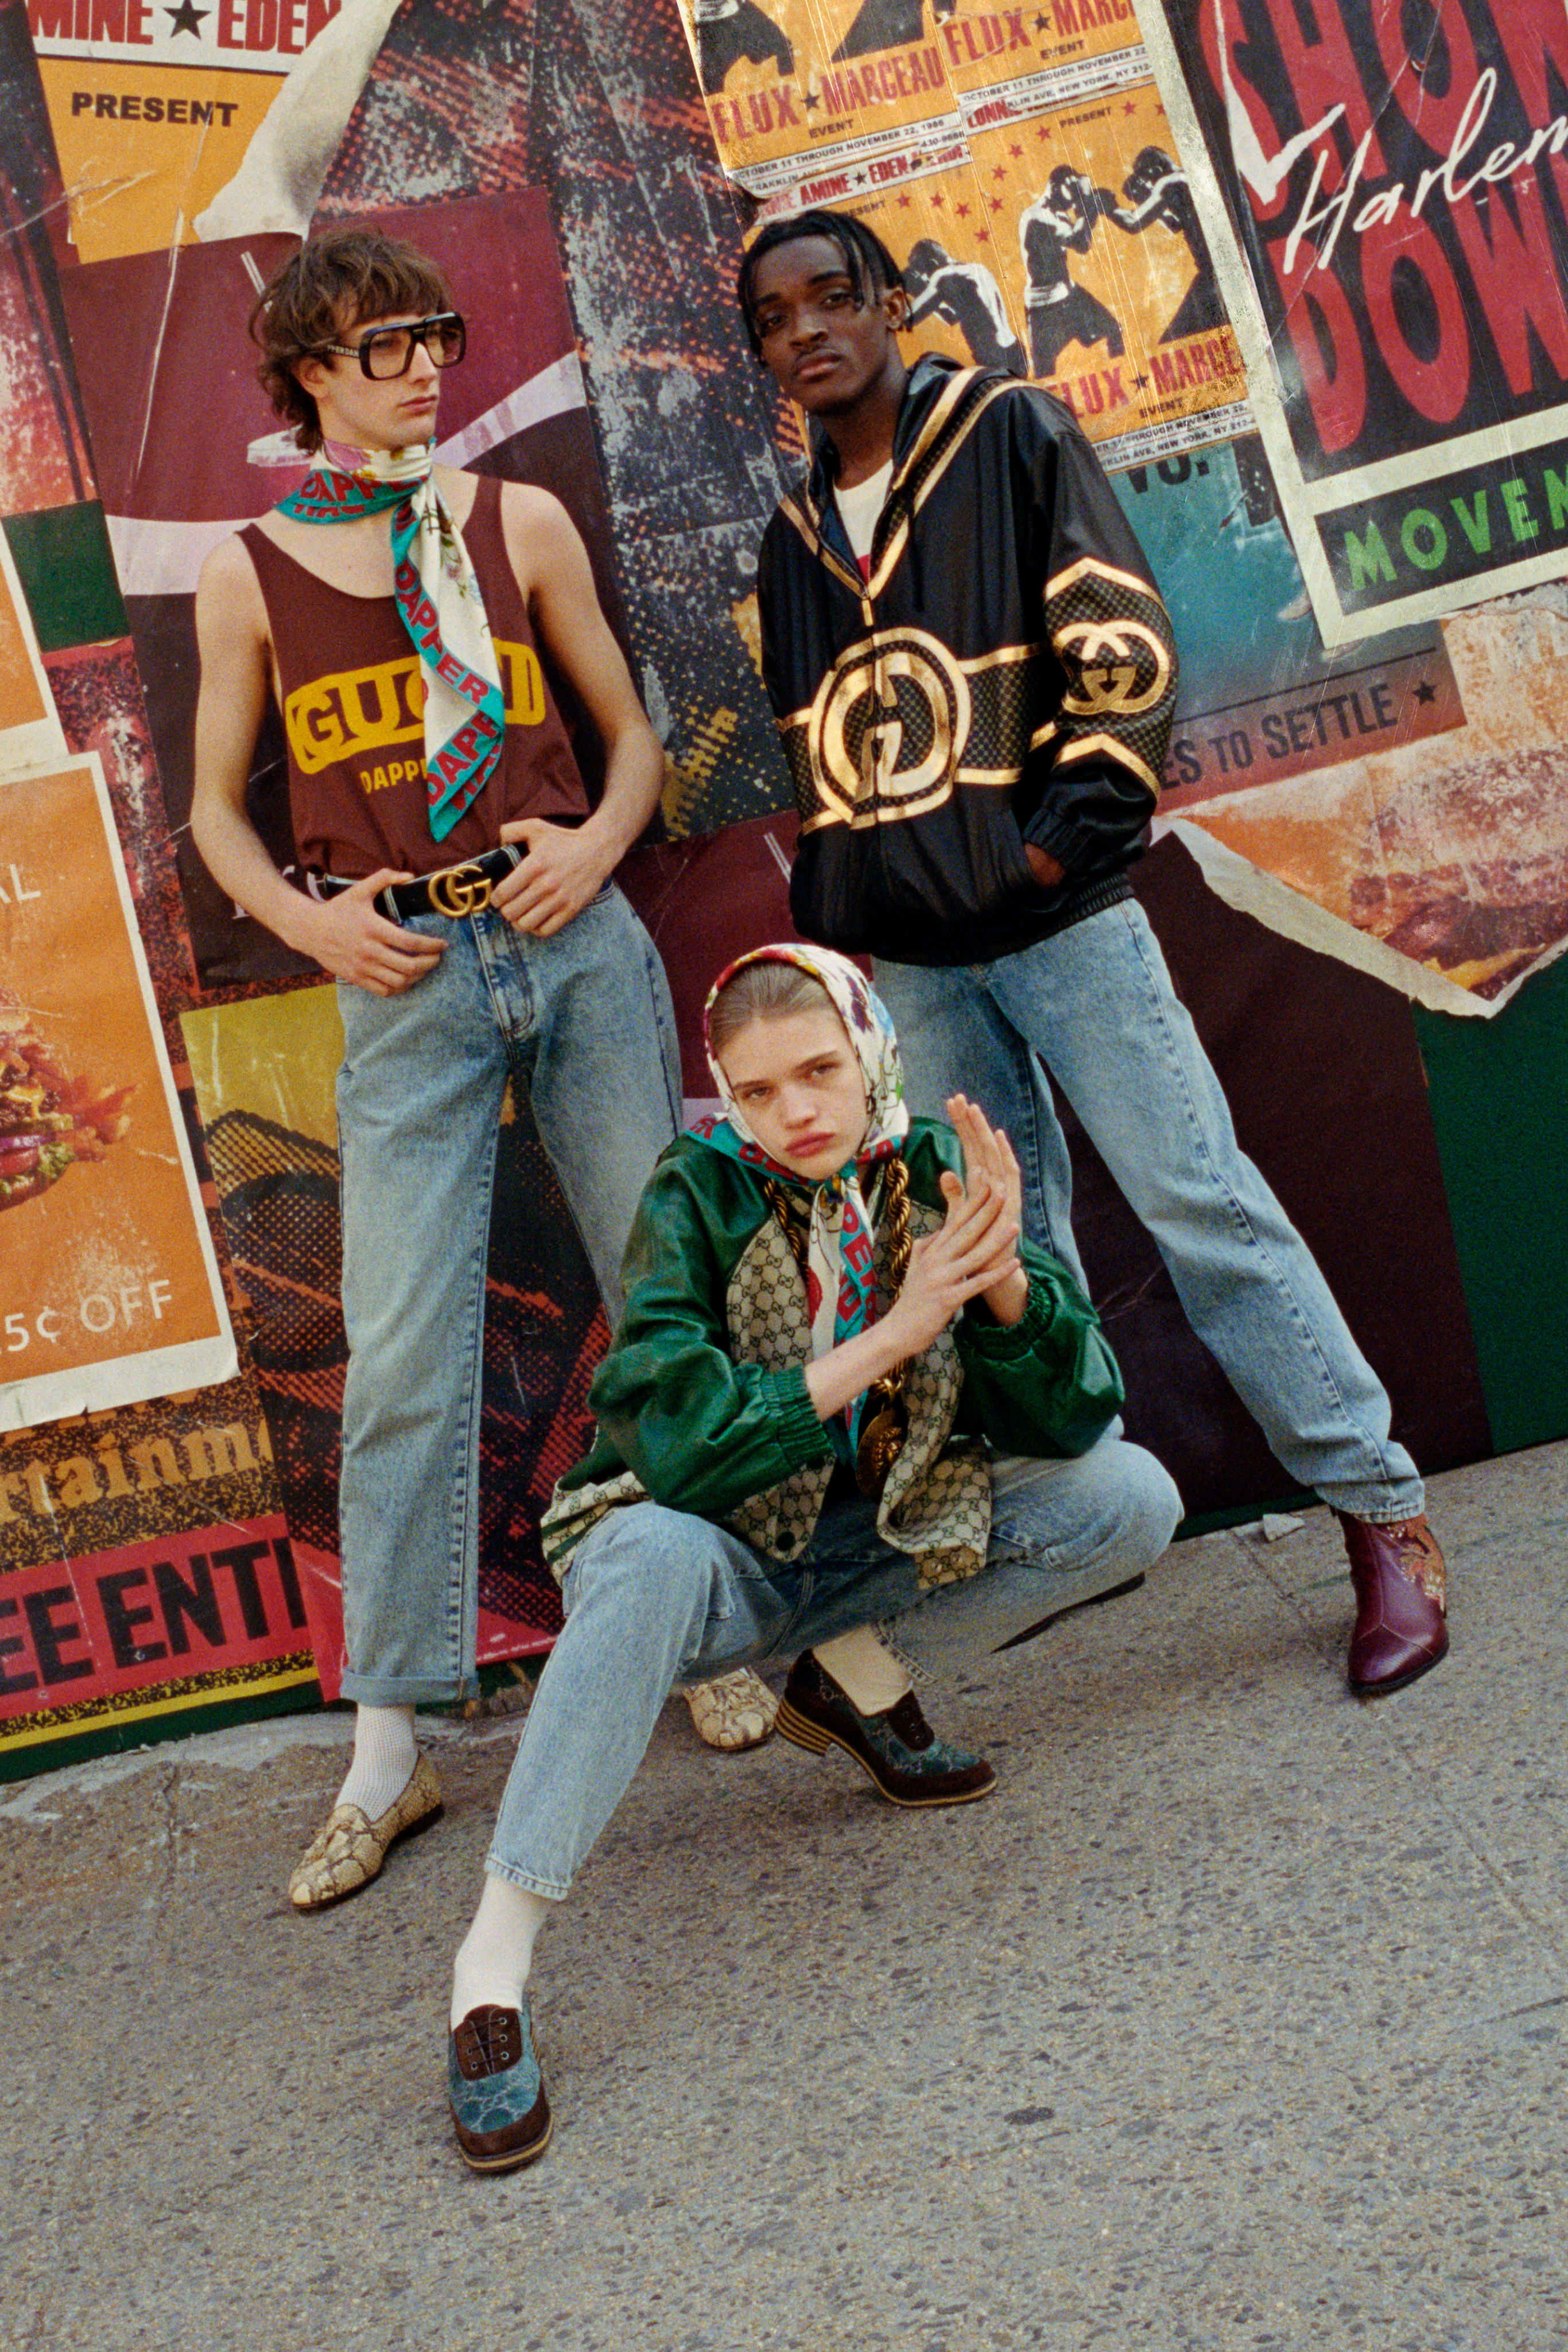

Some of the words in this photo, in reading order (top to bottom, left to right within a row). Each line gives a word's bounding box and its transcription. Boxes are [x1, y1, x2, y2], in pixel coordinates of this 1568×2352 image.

[944, 7, 1031, 66] FLUX
[1040, 40, 1084, 59] EVENT
[964, 85, 1010, 101] OCTOBER
[1027, 67, 1074, 86] THROUGH
[1077, 51, 1132, 71] NOVEMBER
[1059, 82, 1080, 92] NEW
[1116, 69, 1128, 78] NY
[72, 92, 239, 127] PRESENT
[710, 85, 800, 145] FLUX
[820, 46, 946, 115] MARCEAU
[809, 119, 853, 138] EVENT
[1059, 106, 1112, 127] PRESENT
[795, 146, 844, 164] THROUGH
[847, 130, 901, 150] NOVEMBER
[800, 173, 853, 205] AMINE
[868, 154, 910, 184] EDEN
[1139, 397, 1183, 418] EVENT
[1208, 730, 1253, 773] TO
[1262, 682, 1398, 759] SETTLE
[80, 1279, 172, 1332] OFF
